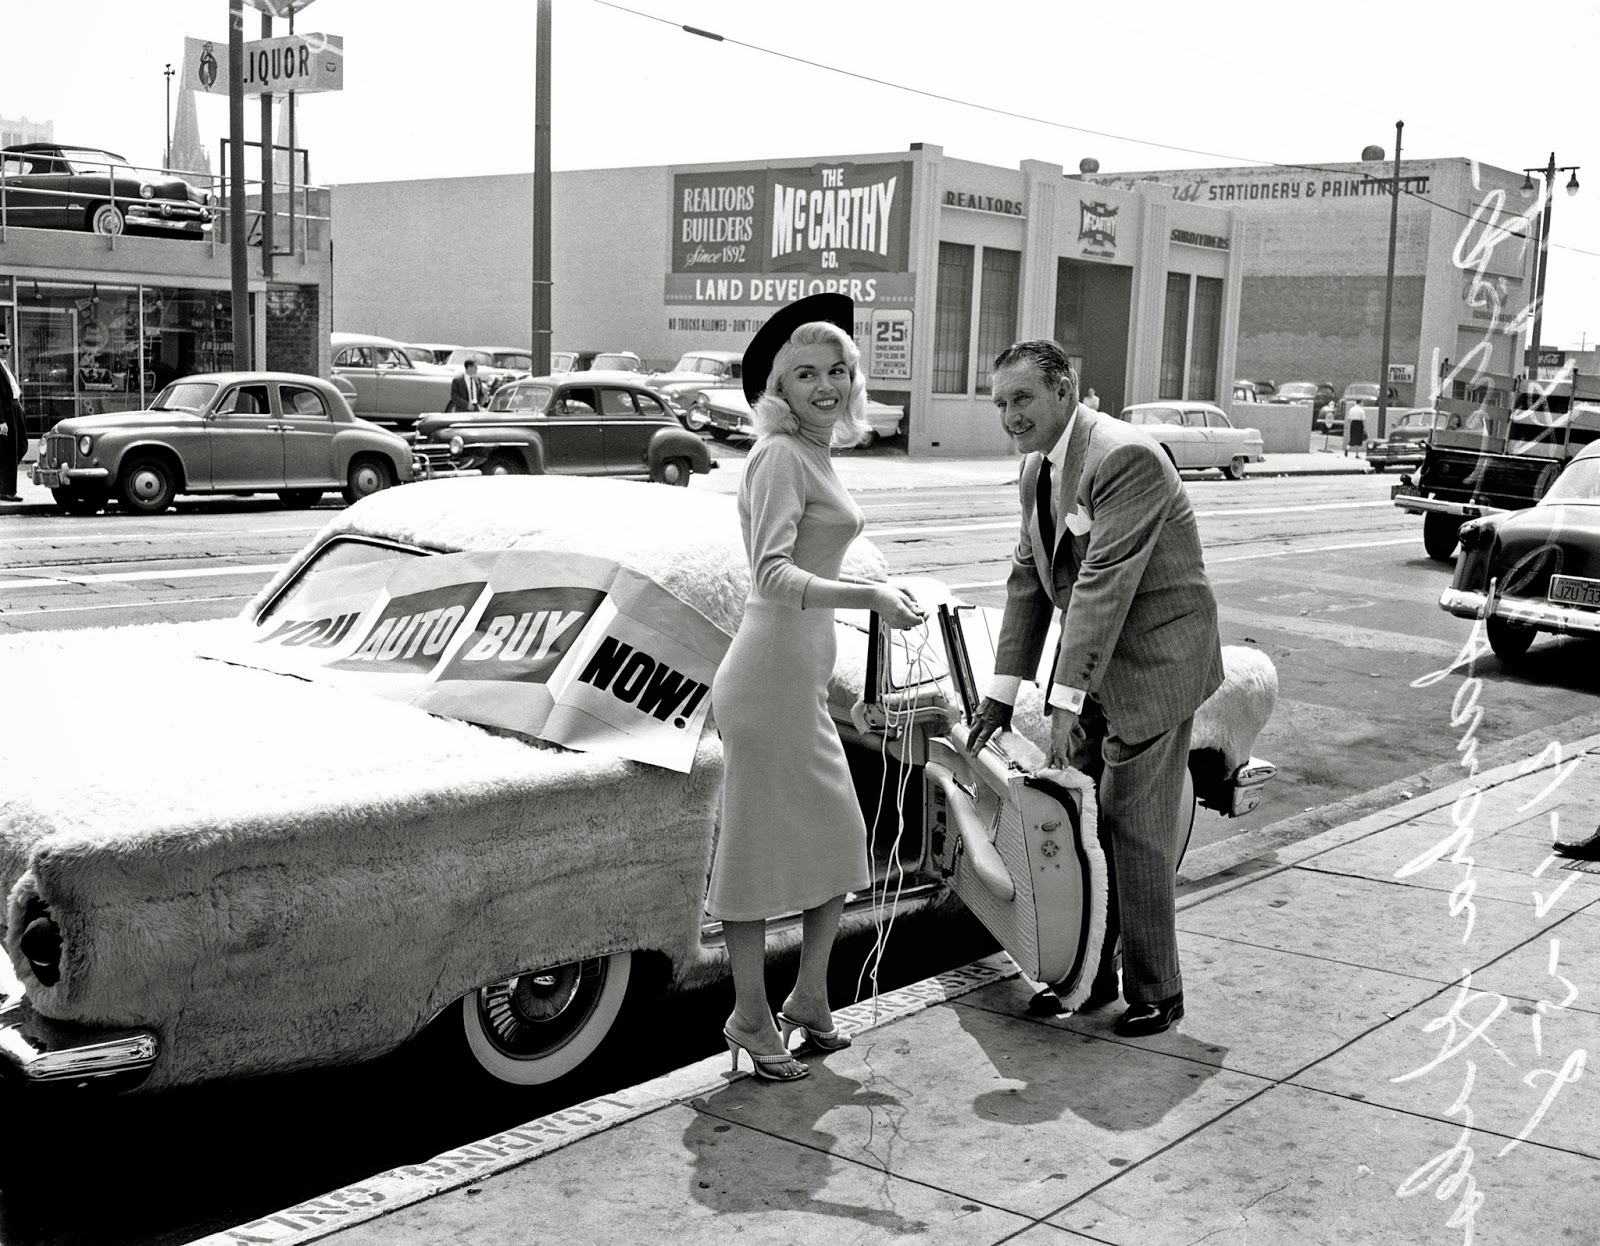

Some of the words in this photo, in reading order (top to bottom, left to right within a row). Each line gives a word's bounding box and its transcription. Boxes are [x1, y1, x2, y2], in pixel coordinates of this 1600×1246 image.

[243, 45, 310, 86] IQUOR
[822, 168, 844, 188] THE
[1209, 182, 1300, 201] STATIONERY
[1305, 182, 1316, 198] &
[1321, 179, 1396, 198] PRINTIN
[683, 185, 755, 213] REALTORS
[946, 190, 1022, 216] REALTORS
[682, 216, 753, 243] BUILDERS
[1170, 228, 1230, 249] SUBDIVIDERS
[684, 245, 722, 268] Since
[722, 244, 746, 263] 1892
[821, 251, 839, 268] CO.
[695, 279, 744, 301] LAND
[750, 279, 877, 302] DEVELOPERS
[668, 318, 676, 331] NO
[678, 318, 700, 331] TRUCKS
[701, 319, 727, 332] ALLOWED
[1555, 585, 1580, 601] JZU
[1582, 587, 1600, 603] 733
[254, 611, 362, 649] YOU
[353, 604, 467, 662] AUTO
[462, 610, 586, 663] BUY
[577, 634, 710, 730] NOW!
[831, 962, 1003, 1030] PASSENGE
[402, 1098, 635, 1181] LOADING
[224, 1186, 387, 1246] ONLY
